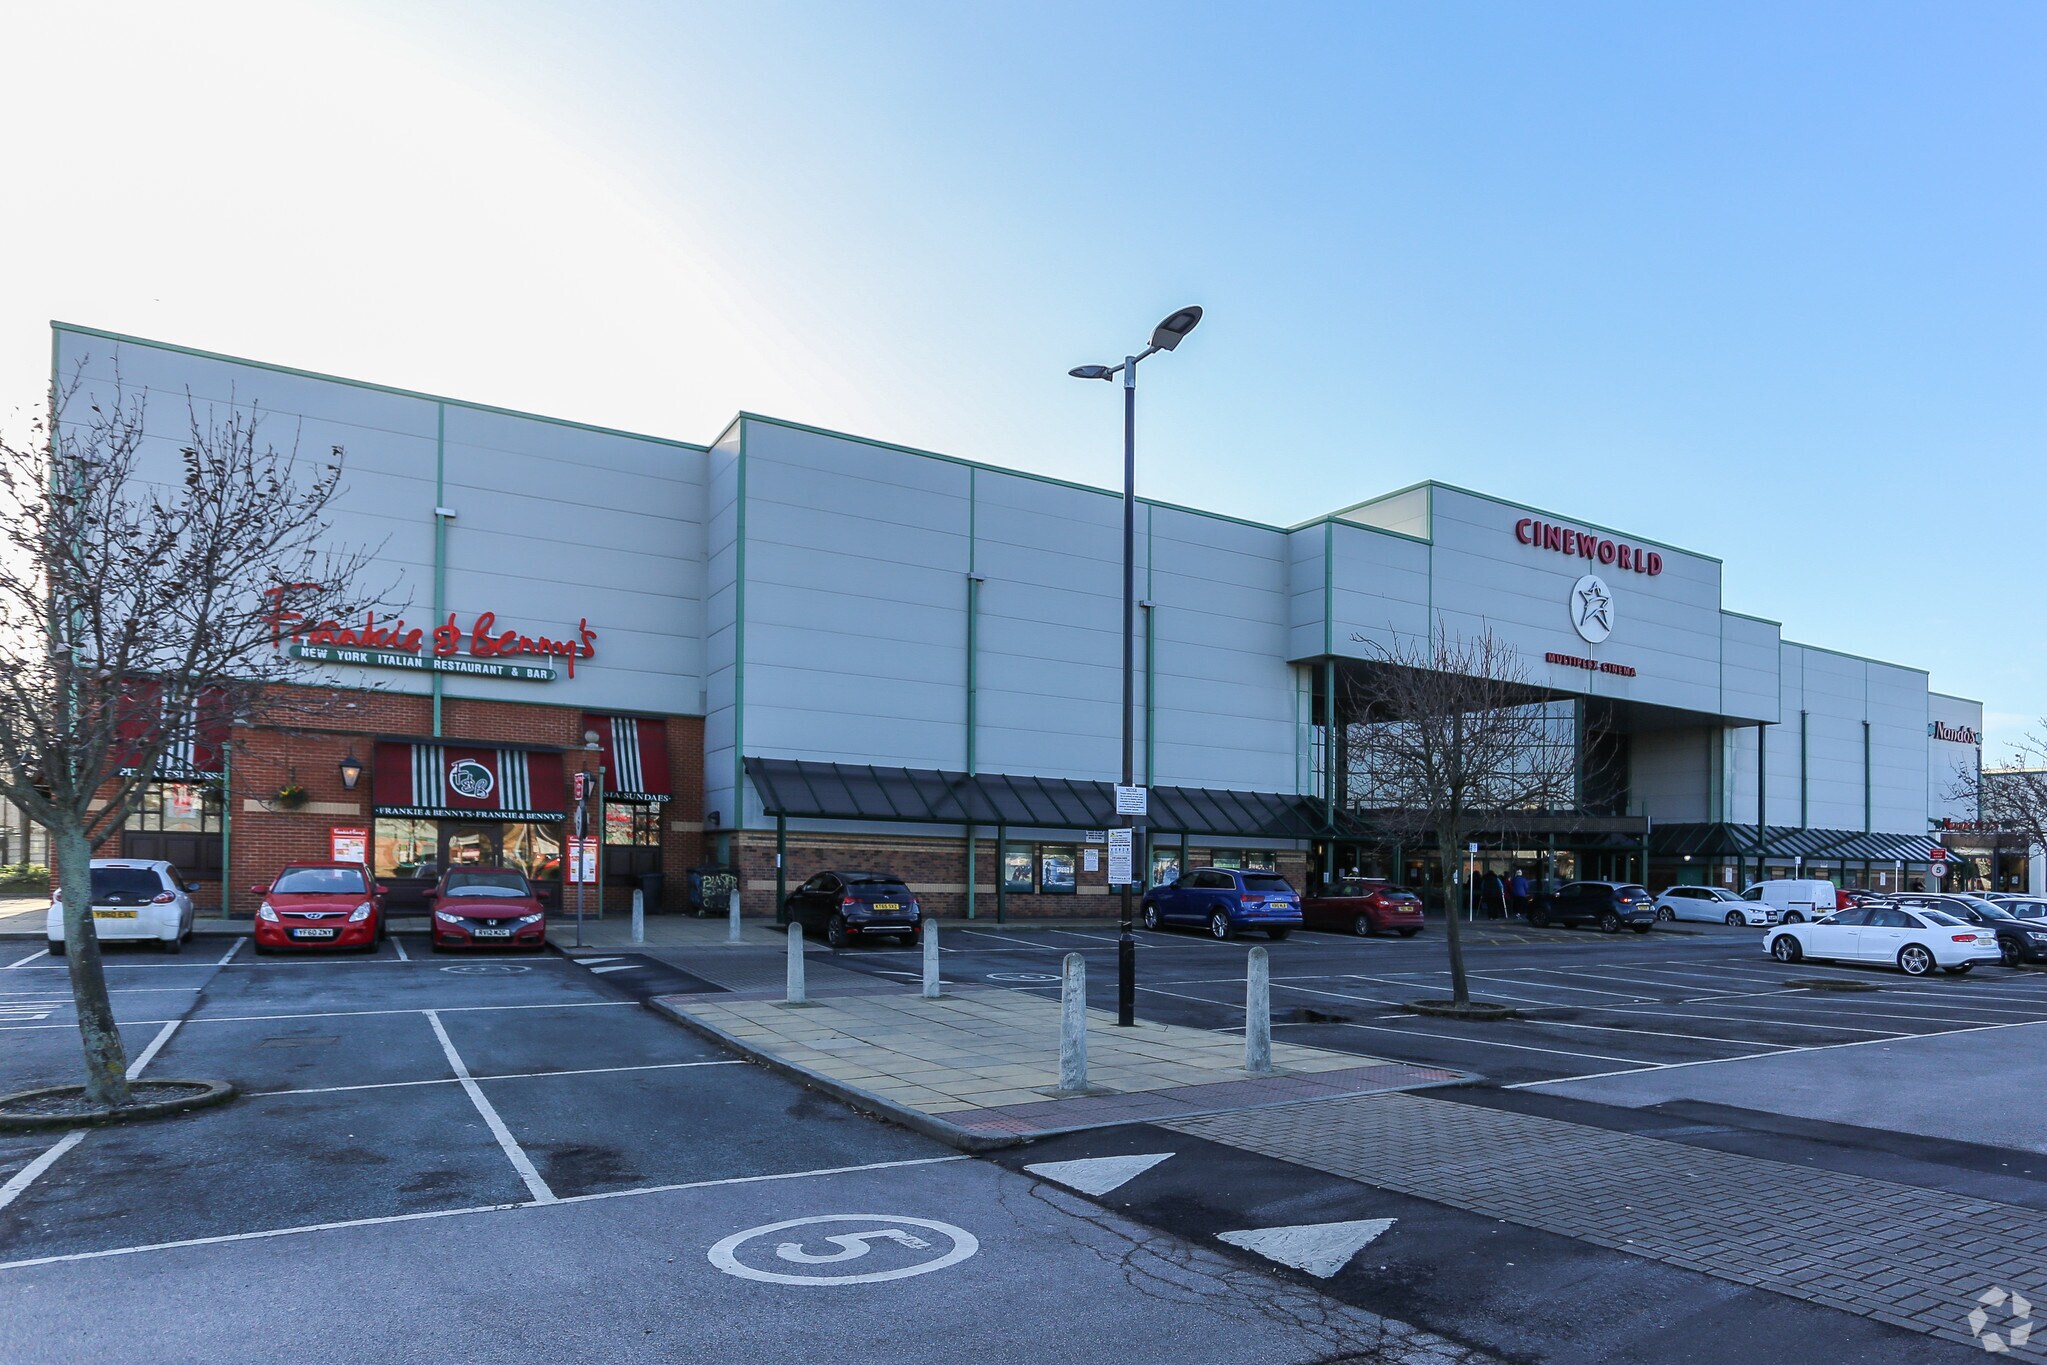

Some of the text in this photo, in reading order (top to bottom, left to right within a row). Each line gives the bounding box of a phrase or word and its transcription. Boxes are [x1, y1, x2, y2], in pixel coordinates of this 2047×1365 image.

[1516, 518, 1663, 576] CINEWORLD
[260, 583, 423, 652] Frankie
[469, 612, 597, 679] Benny's
[301, 647, 548, 680] NEW YORK ITALIAN RESTAURANT & BAR
[1545, 652, 1637, 677] MULTIPLEX CINEMA
[1933, 720, 1976, 745] Nando's
[623, 792, 669, 802] SUNDAES
[379, 807, 424, 816] FRANKIE
[433, 809, 473, 818] BENNY'S
[476, 811, 518, 820] FRANKIE
[526, 813, 564, 821] BENNY'S
[1935, 866, 1942, 874] 5
[298, 928, 332, 937] YF60 ZNY
[776, 1228, 932, 1264] 5
